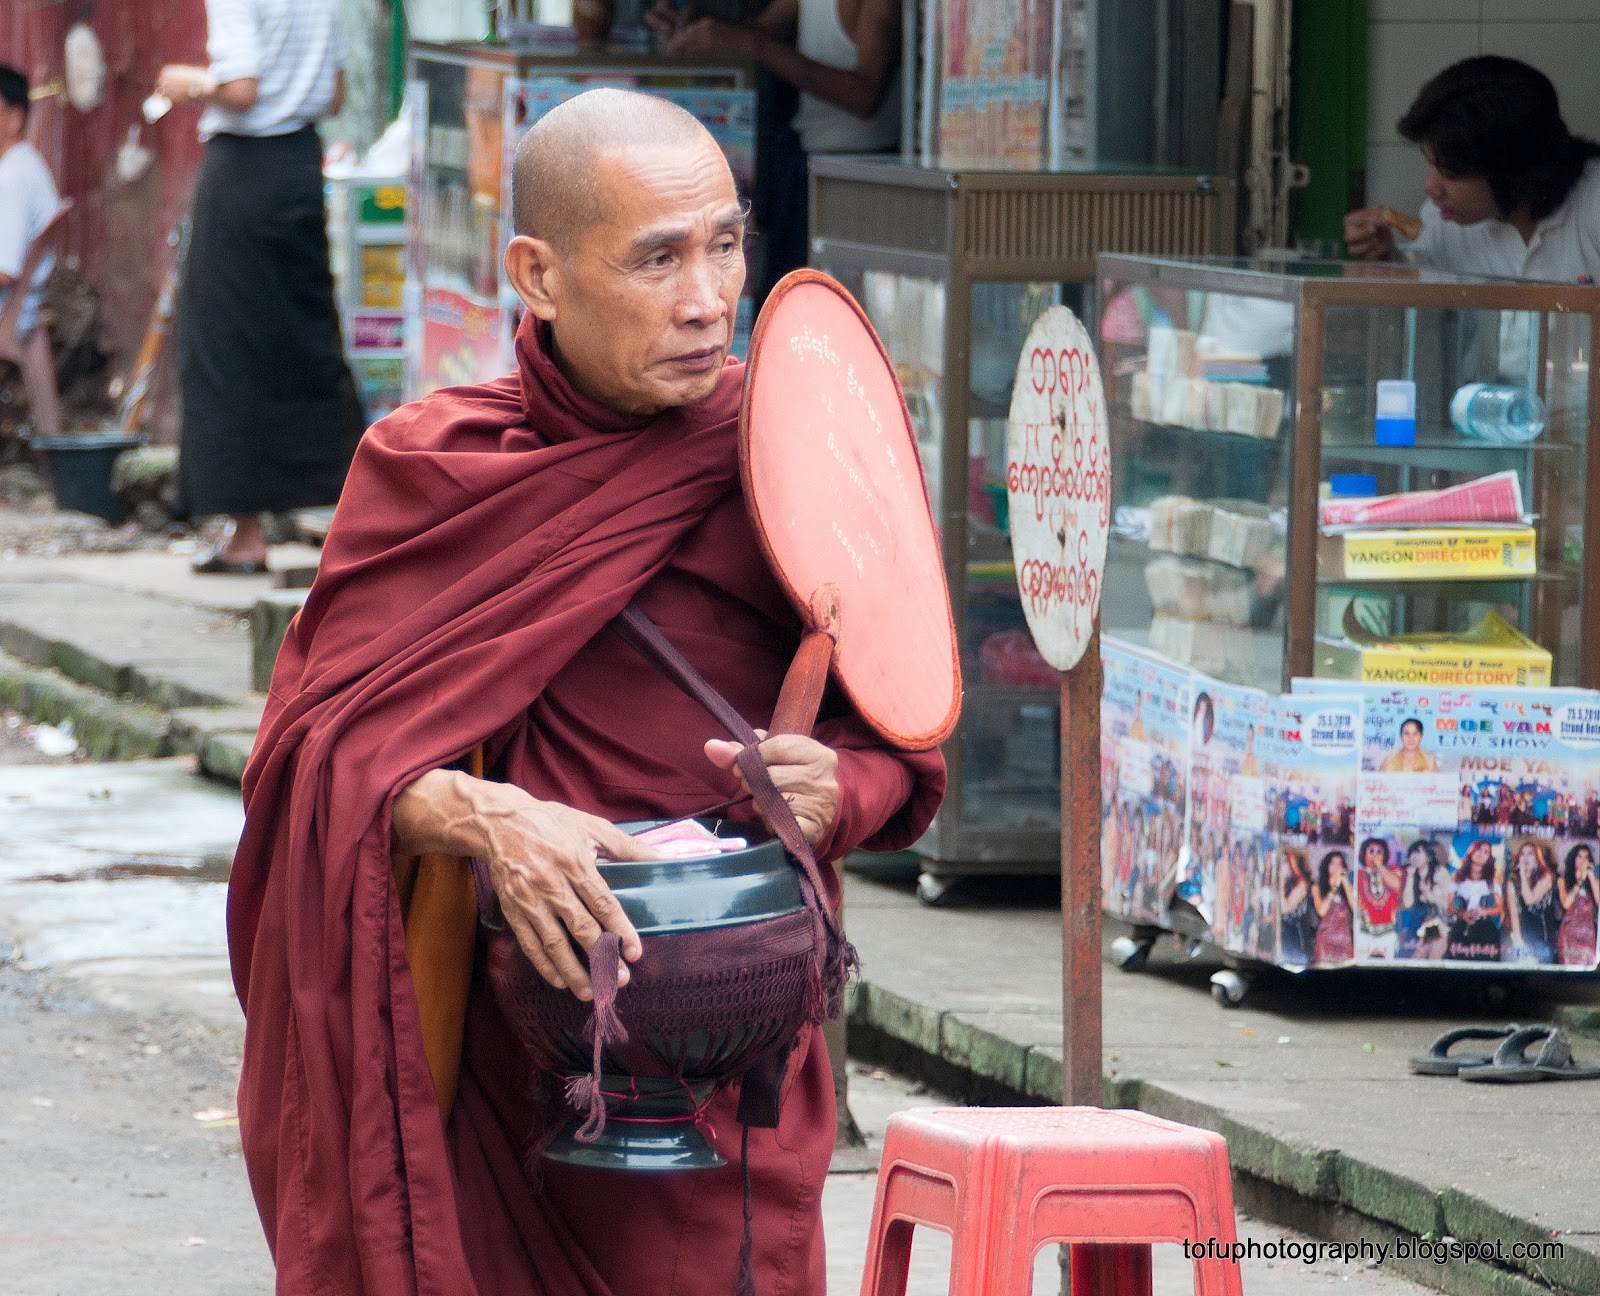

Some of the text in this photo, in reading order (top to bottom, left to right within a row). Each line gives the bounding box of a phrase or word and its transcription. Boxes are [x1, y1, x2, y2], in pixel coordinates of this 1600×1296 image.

[1349, 547, 1499, 565] YANGON DIRECTORY
[1364, 667, 1428, 682] YANGON
[1430, 670, 1514, 685] DIRECTORY
[1436, 717, 1552, 735] MOE YAN
[1438, 735, 1481, 748] LIVE
[1488, 736, 1552, 749] SHOW
[1460, 756, 1512, 772] MOE
